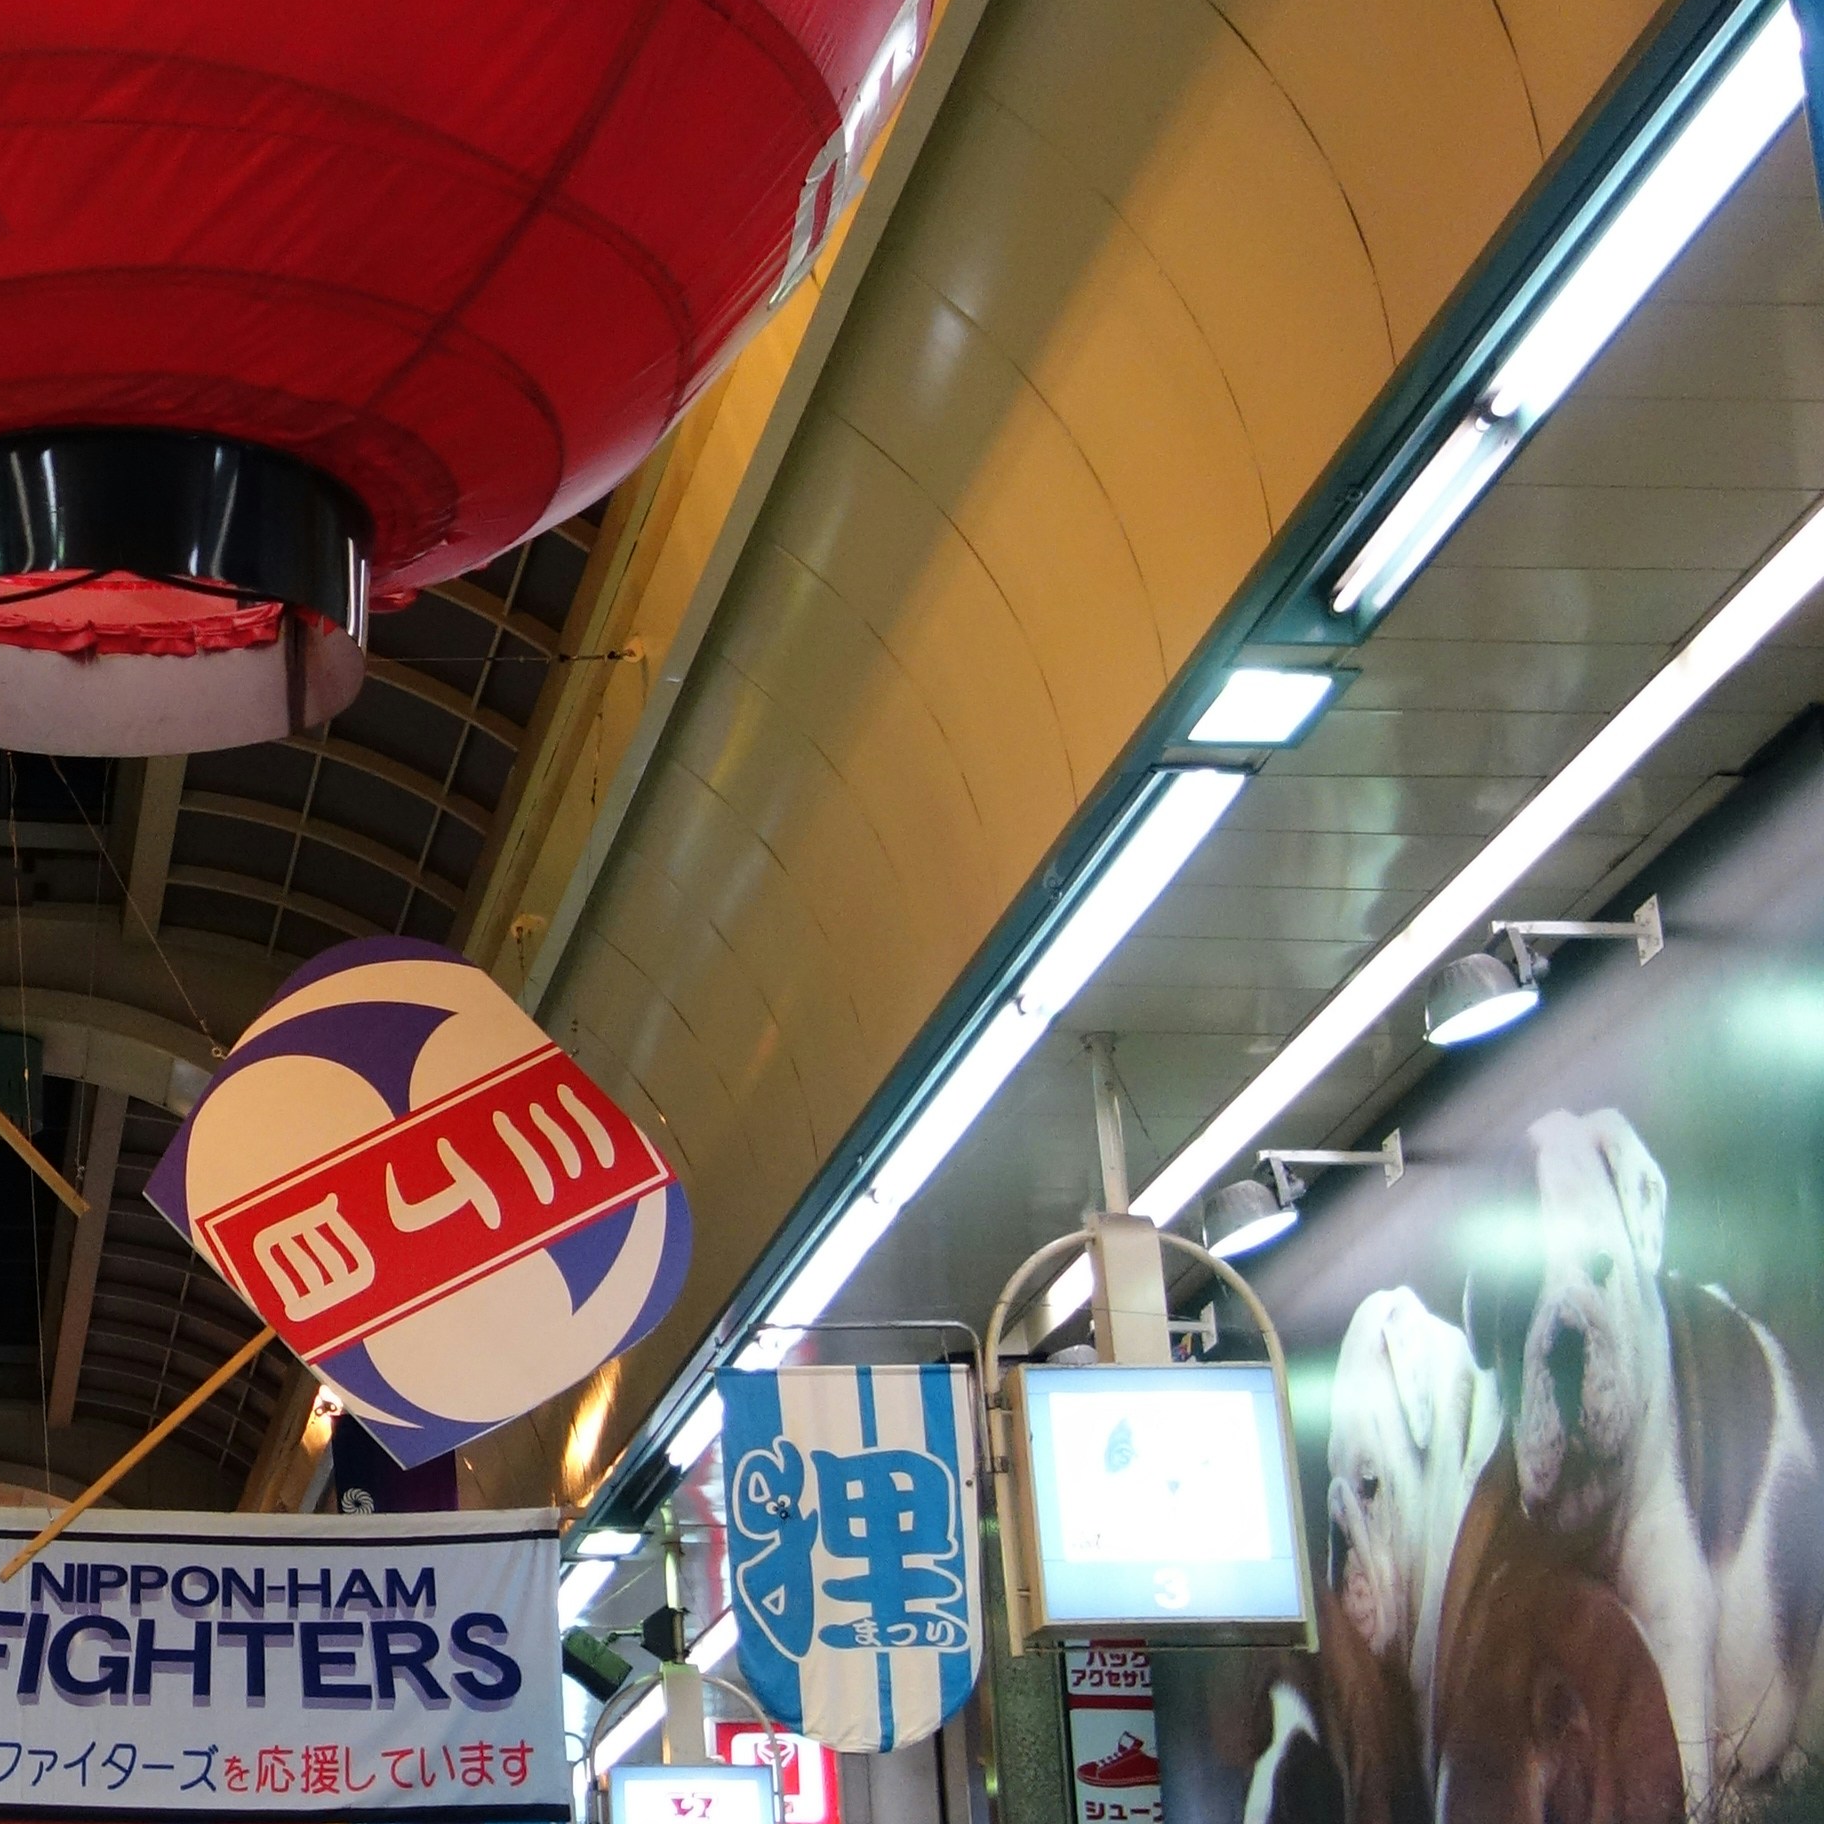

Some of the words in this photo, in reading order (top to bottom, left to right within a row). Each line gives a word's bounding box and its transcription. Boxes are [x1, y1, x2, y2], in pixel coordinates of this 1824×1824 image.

[252, 1083, 615, 1322] 三丁目
[30, 1560, 438, 1616] NIPPON-HAM
[1153, 1568, 1191, 1609] 3
[851, 1619, 956, 1647] まつり
